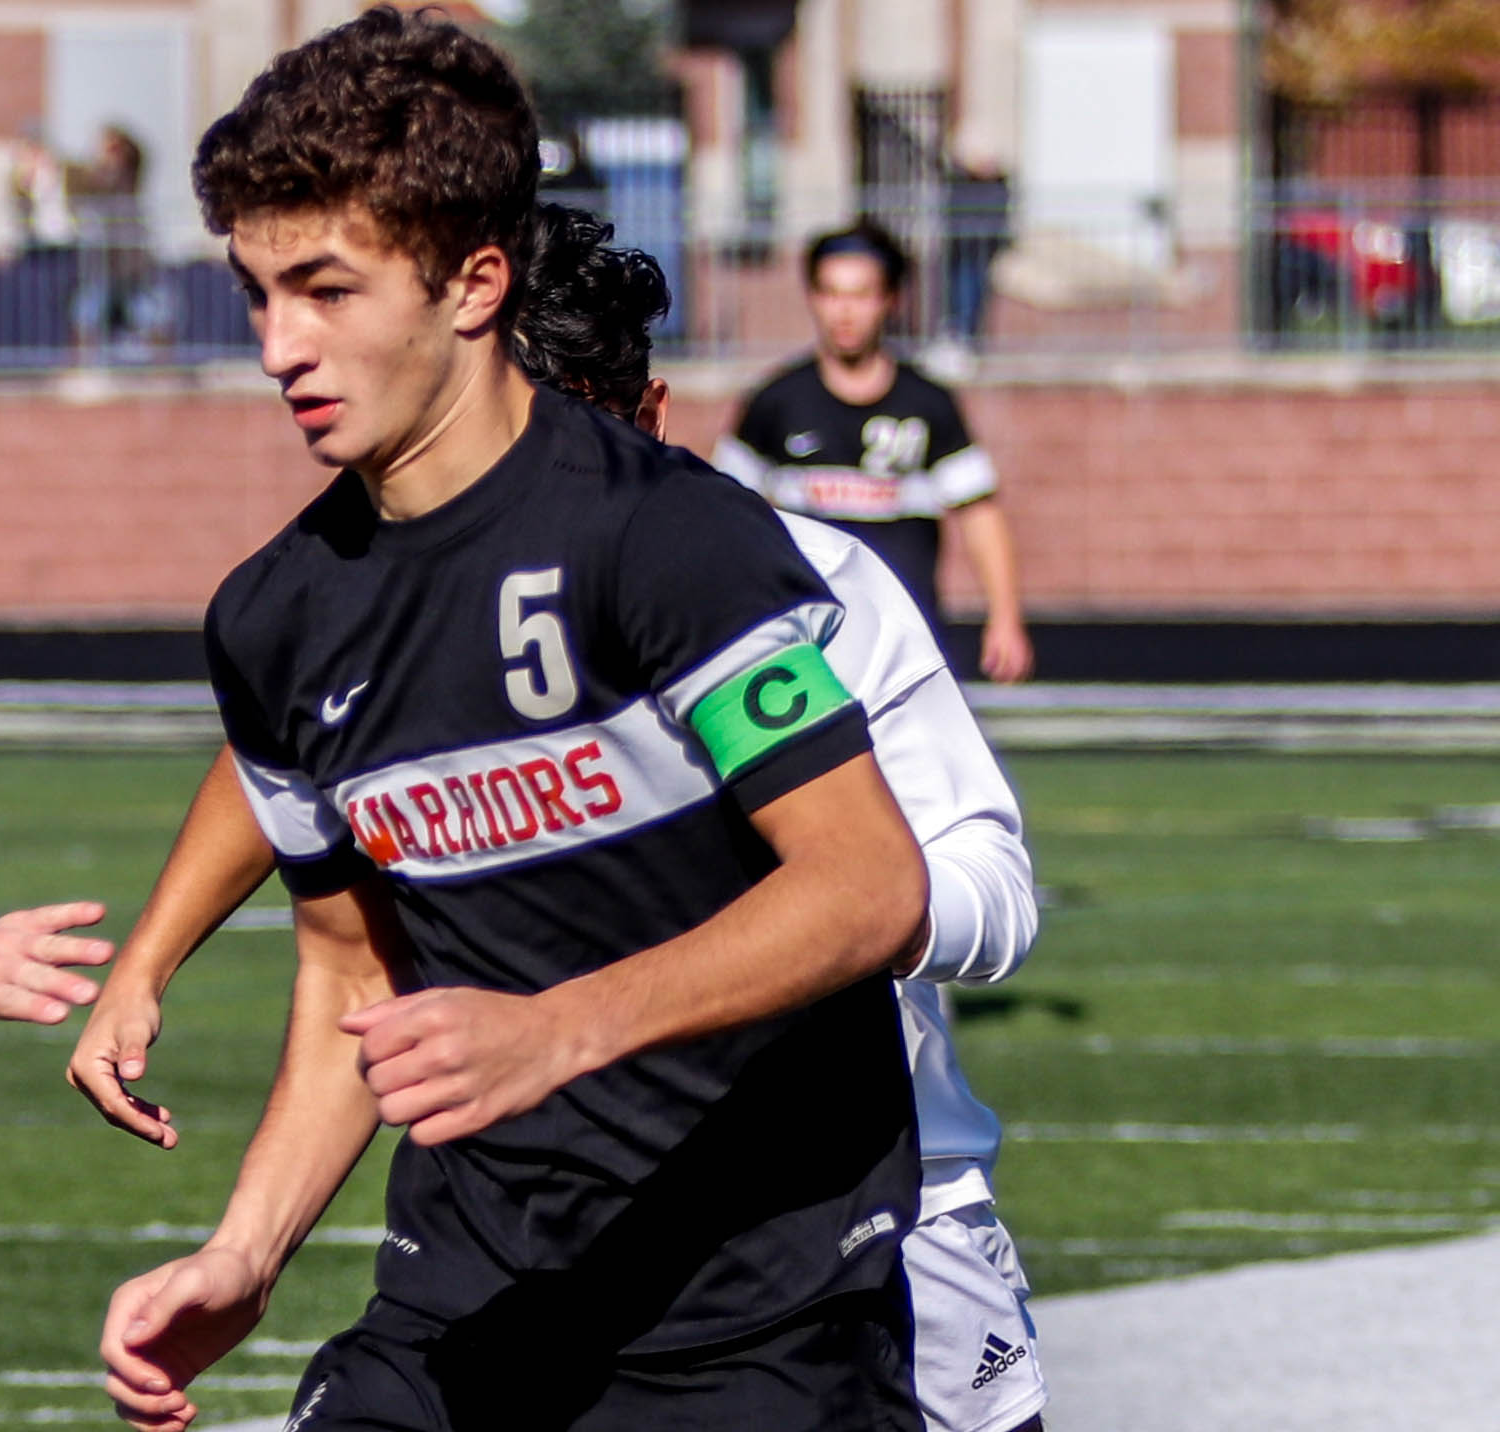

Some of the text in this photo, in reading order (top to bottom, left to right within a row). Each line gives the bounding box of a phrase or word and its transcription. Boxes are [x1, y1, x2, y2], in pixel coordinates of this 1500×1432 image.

[499, 567, 577, 720] 5
[743, 666, 809, 731] C
[347, 740, 623, 867] WARRIORS
[971, 1345, 1027, 1390] adidas
